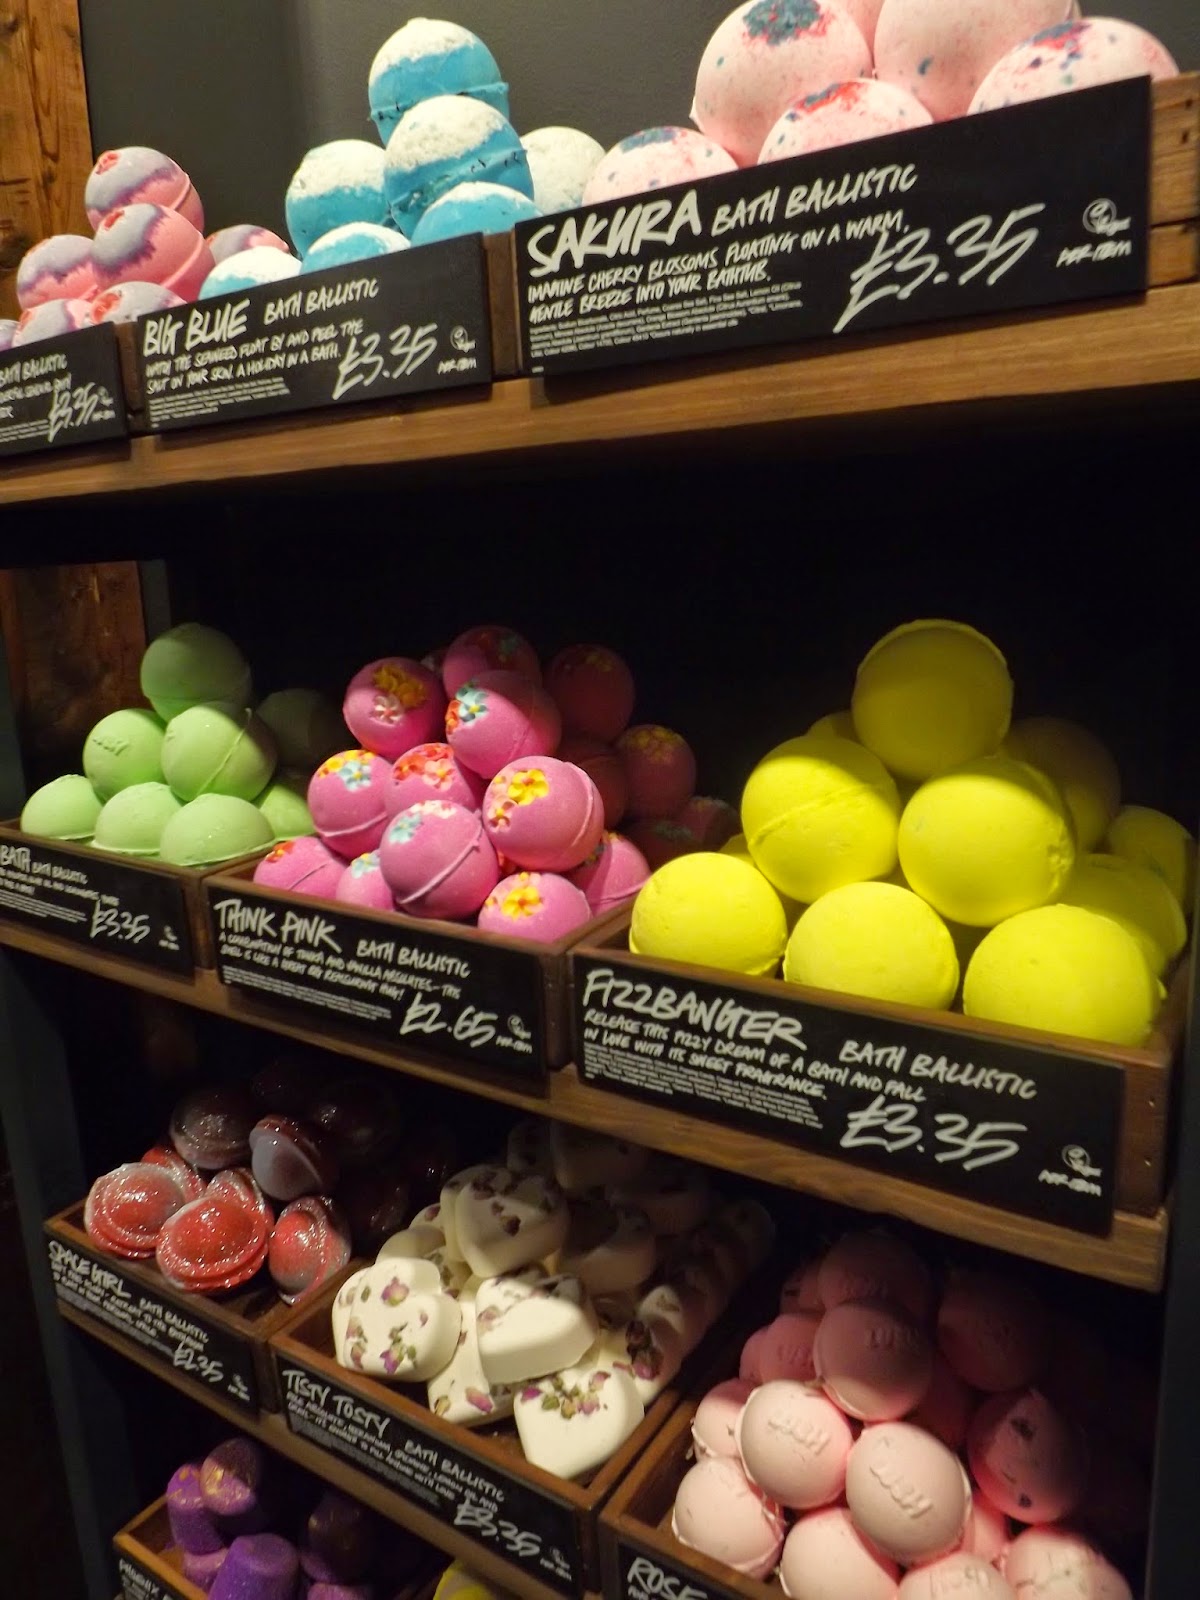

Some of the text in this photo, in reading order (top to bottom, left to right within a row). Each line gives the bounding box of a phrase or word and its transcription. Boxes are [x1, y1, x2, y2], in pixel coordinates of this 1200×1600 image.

[527, 163, 918, 278] SAKURA BATH BALLISTIC
[588, 263, 644, 293] CHERRY
[648, 247, 719, 282] BLOSSOMS
[724, 232, 800, 267] FLOATING
[801, 226, 823, 251] ON
[826, 221, 841, 245] A
[579, 285, 633, 314] BREEZE
[636, 277, 664, 304] INTO
[667, 272, 702, 298] YOUR
[832, 202, 1047, 334] £3.35
[143, 278, 379, 357] BIG BLUE BATH BALLISTIC
[286, 330, 309, 347] AND
[341, 318, 364, 337] THE
[236, 362, 246, 378] A
[300, 350, 310, 364] A
[332, 322, 438, 400] £3.35
[213, 898, 277, 938] THINK
[280, 910, 343, 954] PINK
[356, 939, 395, 964] BATH
[397, 946, 471, 978] BALLISTIC
[400, 992, 498, 1048] £2.65
[583, 968, 1038, 1100] FIZZBANGER BATH BALLISTIC
[584, 1028, 598, 1041] IN
[603, 1030, 630, 1048] LOVE
[634, 1039, 664, 1057] WITH
[669, 1046, 685, 1063] ITS
[688, 1053, 734, 1075] SWEET
[585, 1008, 642, 1034] RELEASE
[643, 1022, 670, 1041] THIS
[714, 1038, 765, 1064] DREAM
[769, 1052, 790, 1069] OF
[791, 1056, 804, 1073] A
[807, 1060, 848, 1087] BATH
[850, 1072, 882, 1093] AND
[882, 1079, 927, 1103] FALL
[840, 1094, 1028, 1171] £3.35
[282, 1370, 331, 1407] TISTY
[332, 1395, 391, 1439] TOSTY
[404, 1439, 438, 1466] BATH
[441, 1458, 505, 1502] BALLISTIC
